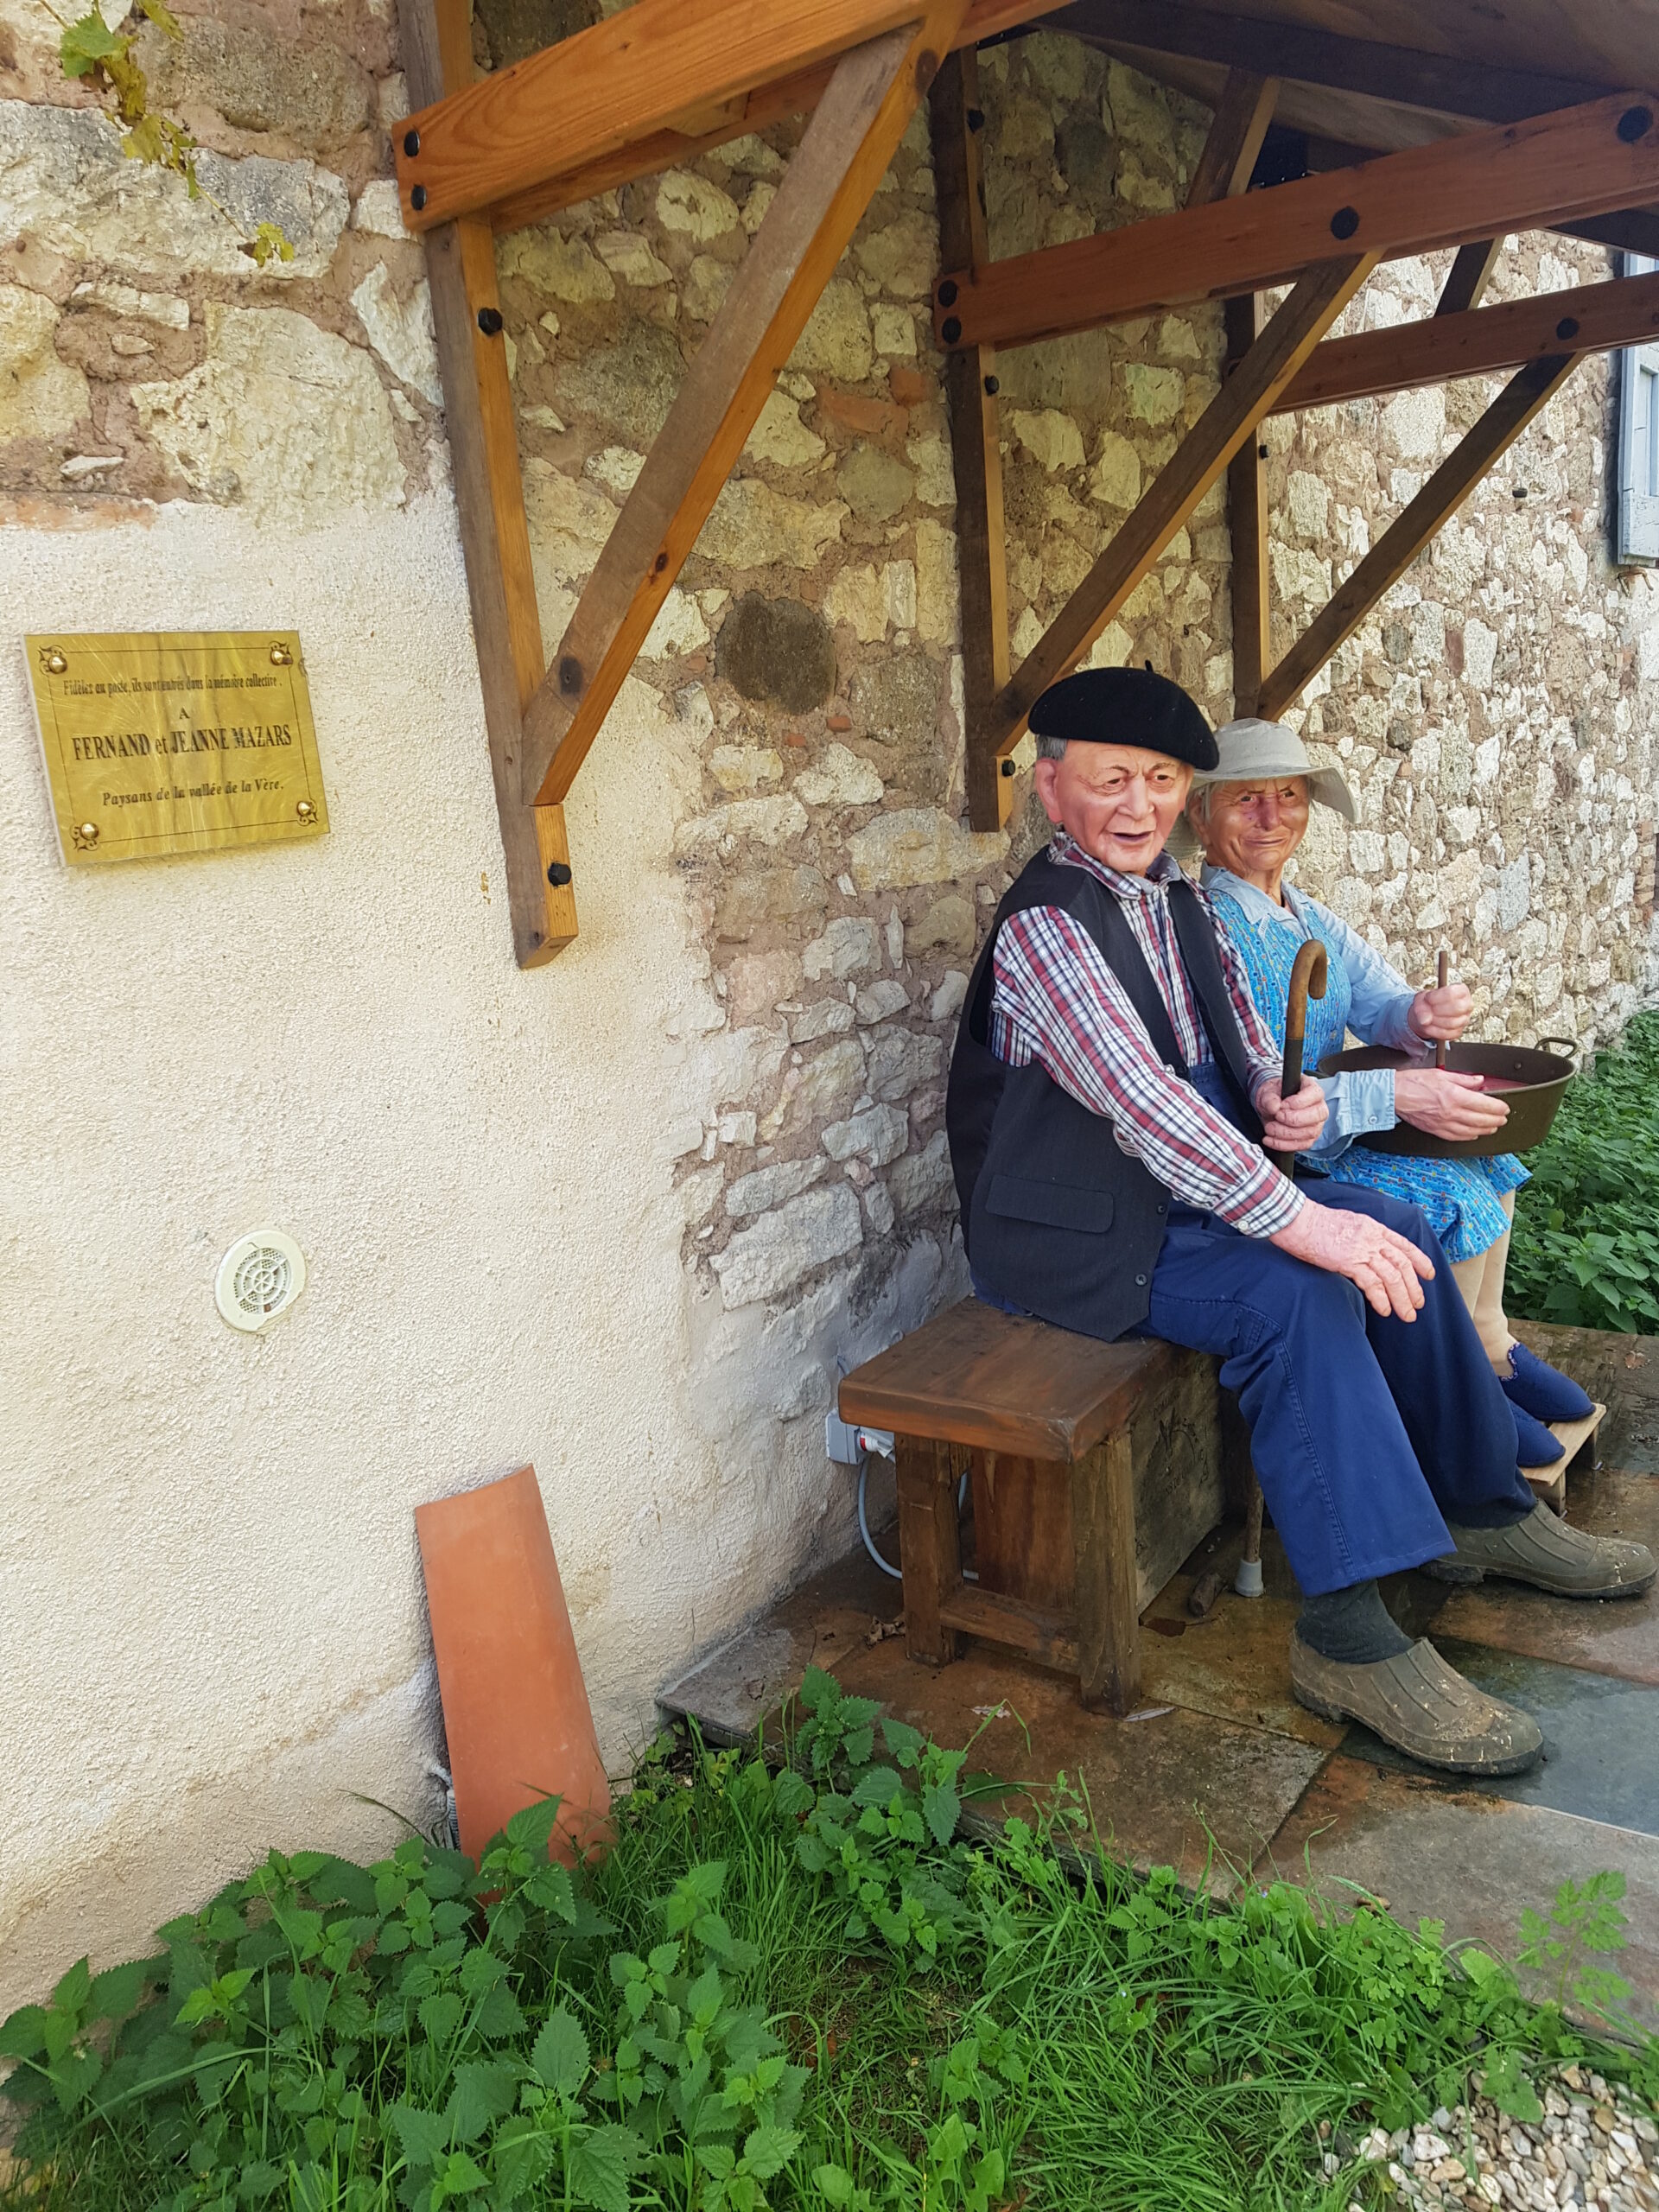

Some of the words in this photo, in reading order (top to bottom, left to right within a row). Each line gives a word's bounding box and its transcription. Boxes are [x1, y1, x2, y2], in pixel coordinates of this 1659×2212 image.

[95, 683, 106, 694] au
[131, 677, 142, 692] ils
[144, 679, 160, 692] sont
[186, 676, 203, 690] dans
[206, 675, 213, 689] la
[213, 674, 244, 689] mémoire
[72, 734, 151, 760] FERNAND
[155, 735, 168, 754] et
[170, 728, 230, 753] JEANNE
[232, 724, 292, 749] MAZARS
[102, 791, 153, 808] Paysans
[156, 787, 170, 800] de
[174, 785, 185, 798] la
[189, 782, 222, 797] vallée
[225, 781, 238, 794] de
[241, 780, 252, 792] la
[255, 778, 284, 791] Vère.
